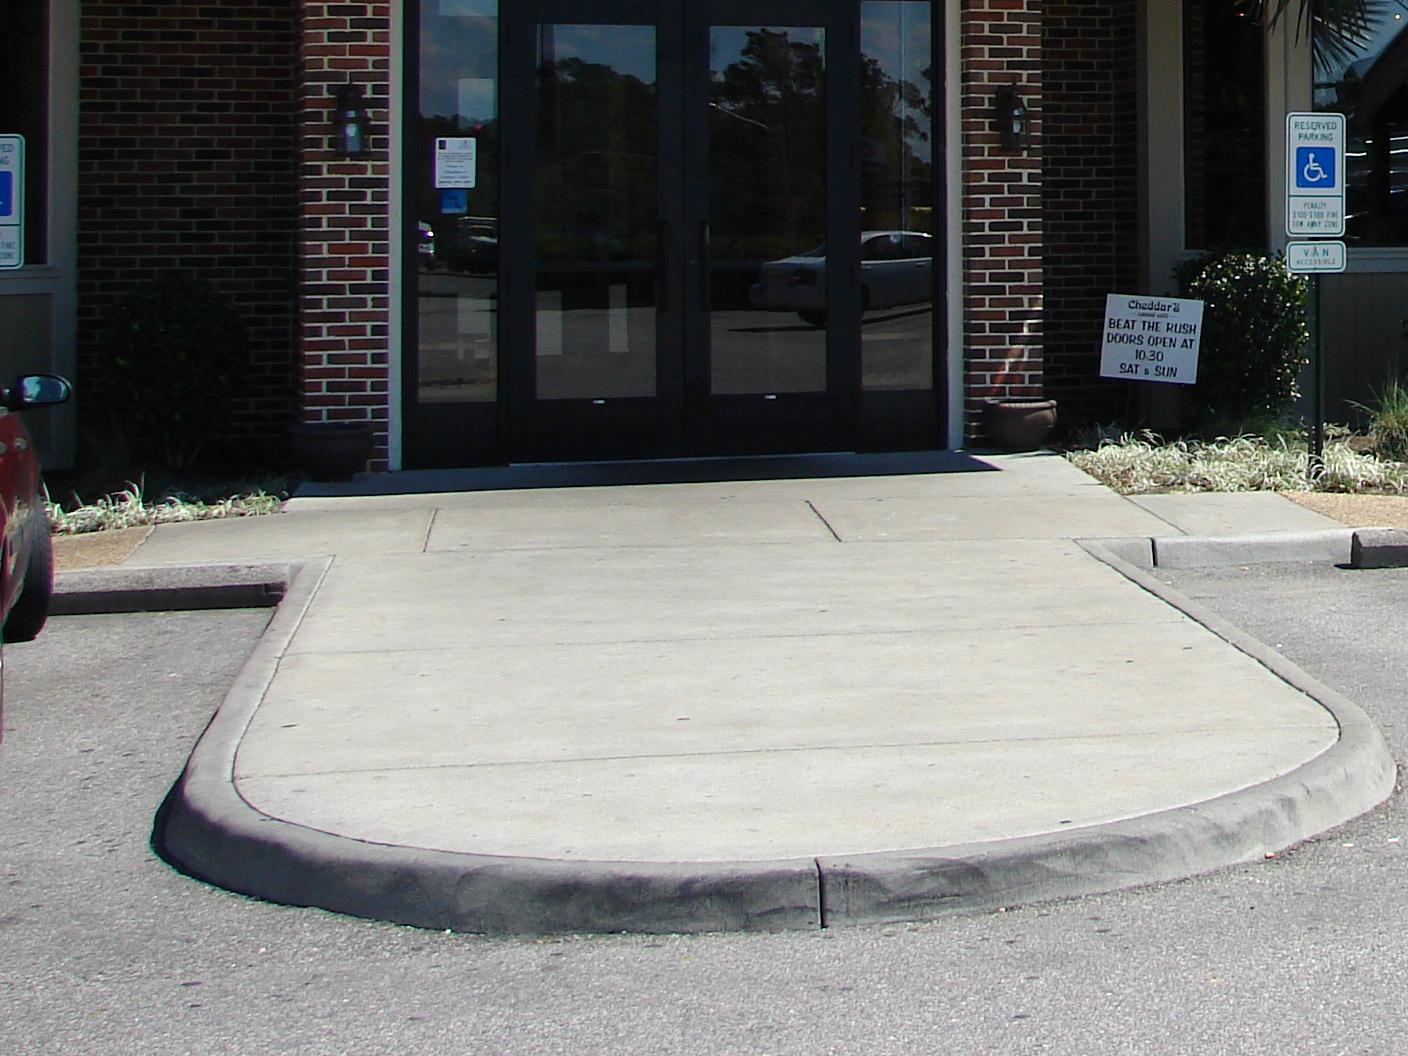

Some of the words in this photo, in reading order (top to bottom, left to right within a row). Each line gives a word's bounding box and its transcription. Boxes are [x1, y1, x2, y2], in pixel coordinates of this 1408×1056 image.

[1294, 121, 1337, 131] RESERVED
[1298, 132, 1333, 141] PARKING
[1303, 247, 1329, 256] VAN
[1108, 318, 1137, 330] BEAT
[1141, 320, 1161, 332] THE
[1166, 322, 1197, 334] RUSH
[1106, 333, 1144, 345] DOORS
[1147, 335, 1177, 348] OPEN
[1180, 338, 1195, 349] AT
[1119, 362, 1140, 374] SAT
[1154, 365, 1178, 377] SUN
